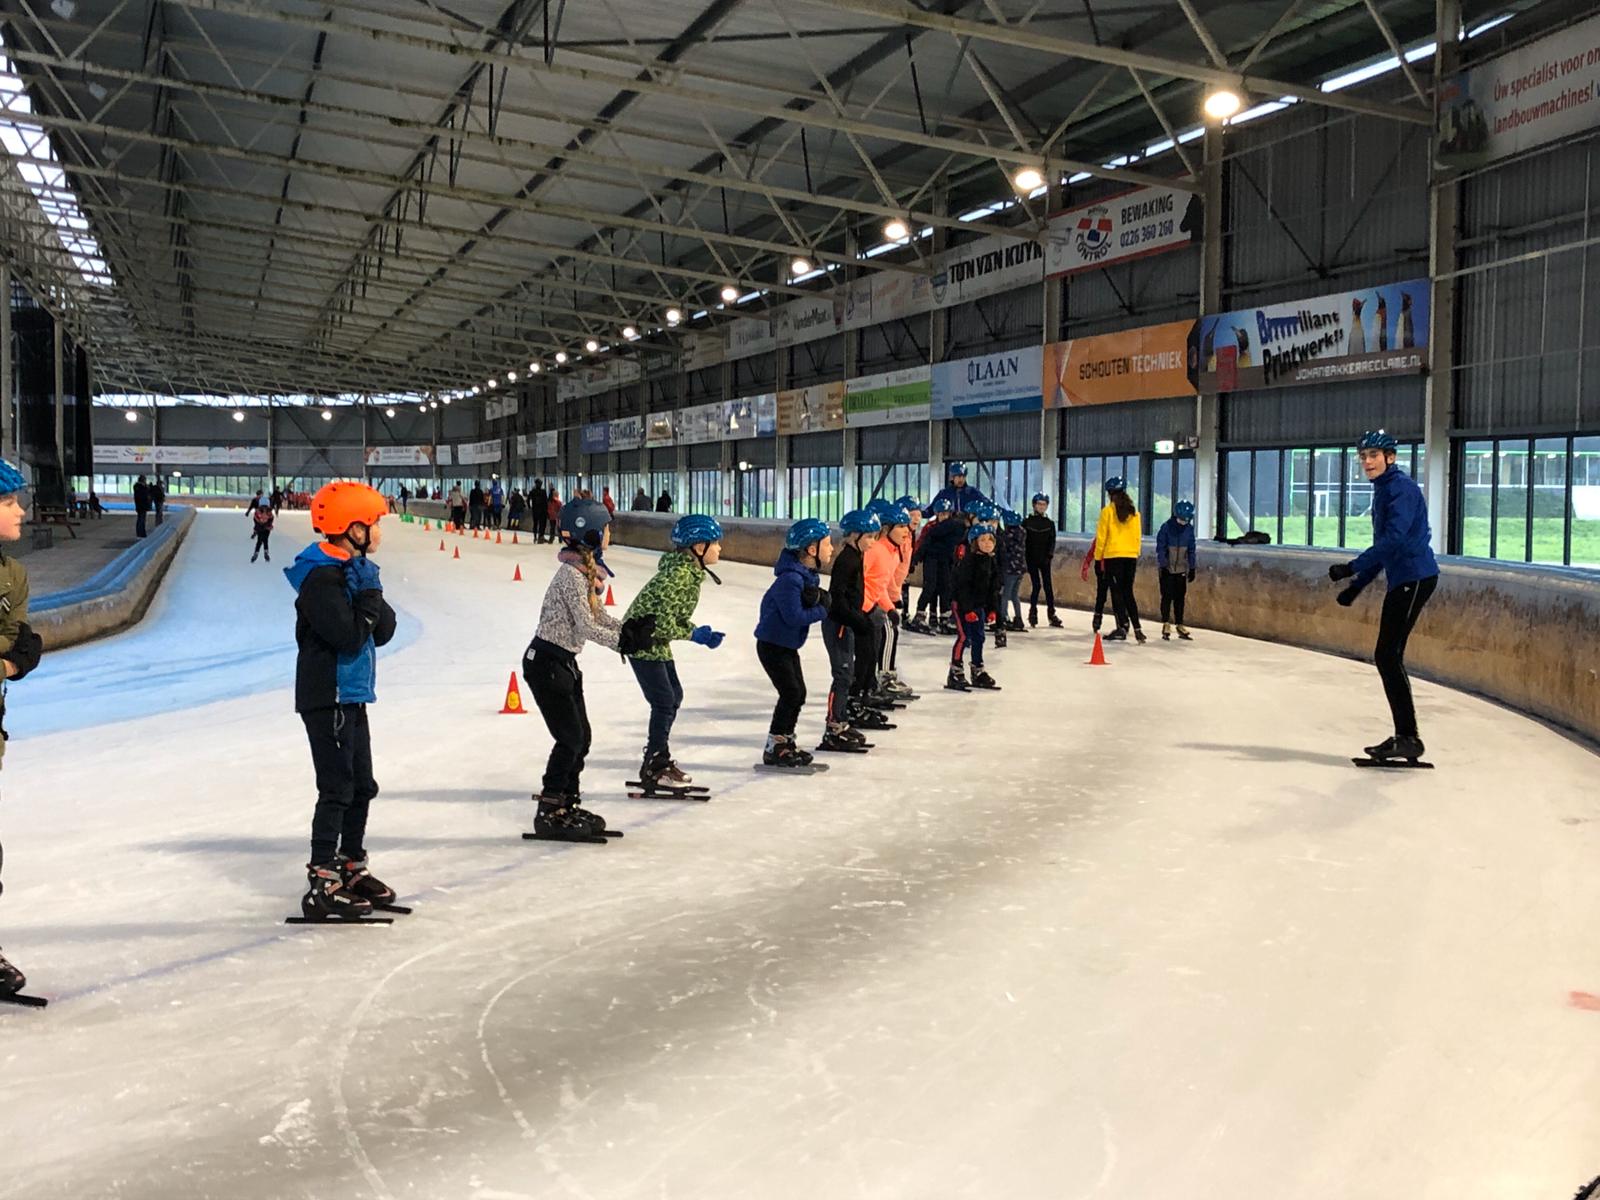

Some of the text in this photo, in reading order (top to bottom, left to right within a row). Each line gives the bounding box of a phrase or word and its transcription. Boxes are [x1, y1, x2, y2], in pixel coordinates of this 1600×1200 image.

[1494, 80, 1509, 101] Uw
[1510, 61, 1558, 98] specialist
[1561, 54, 1585, 76] voor
[1494, 80, 1594, 134] landbouwmachines!
[1121, 193, 1173, 225] BEWAKING
[1120, 228, 1140, 248] 0226
[976, 248, 1003, 276] VAN
[1079, 350, 1182, 381] SCHOUTEN TECHNIEK
